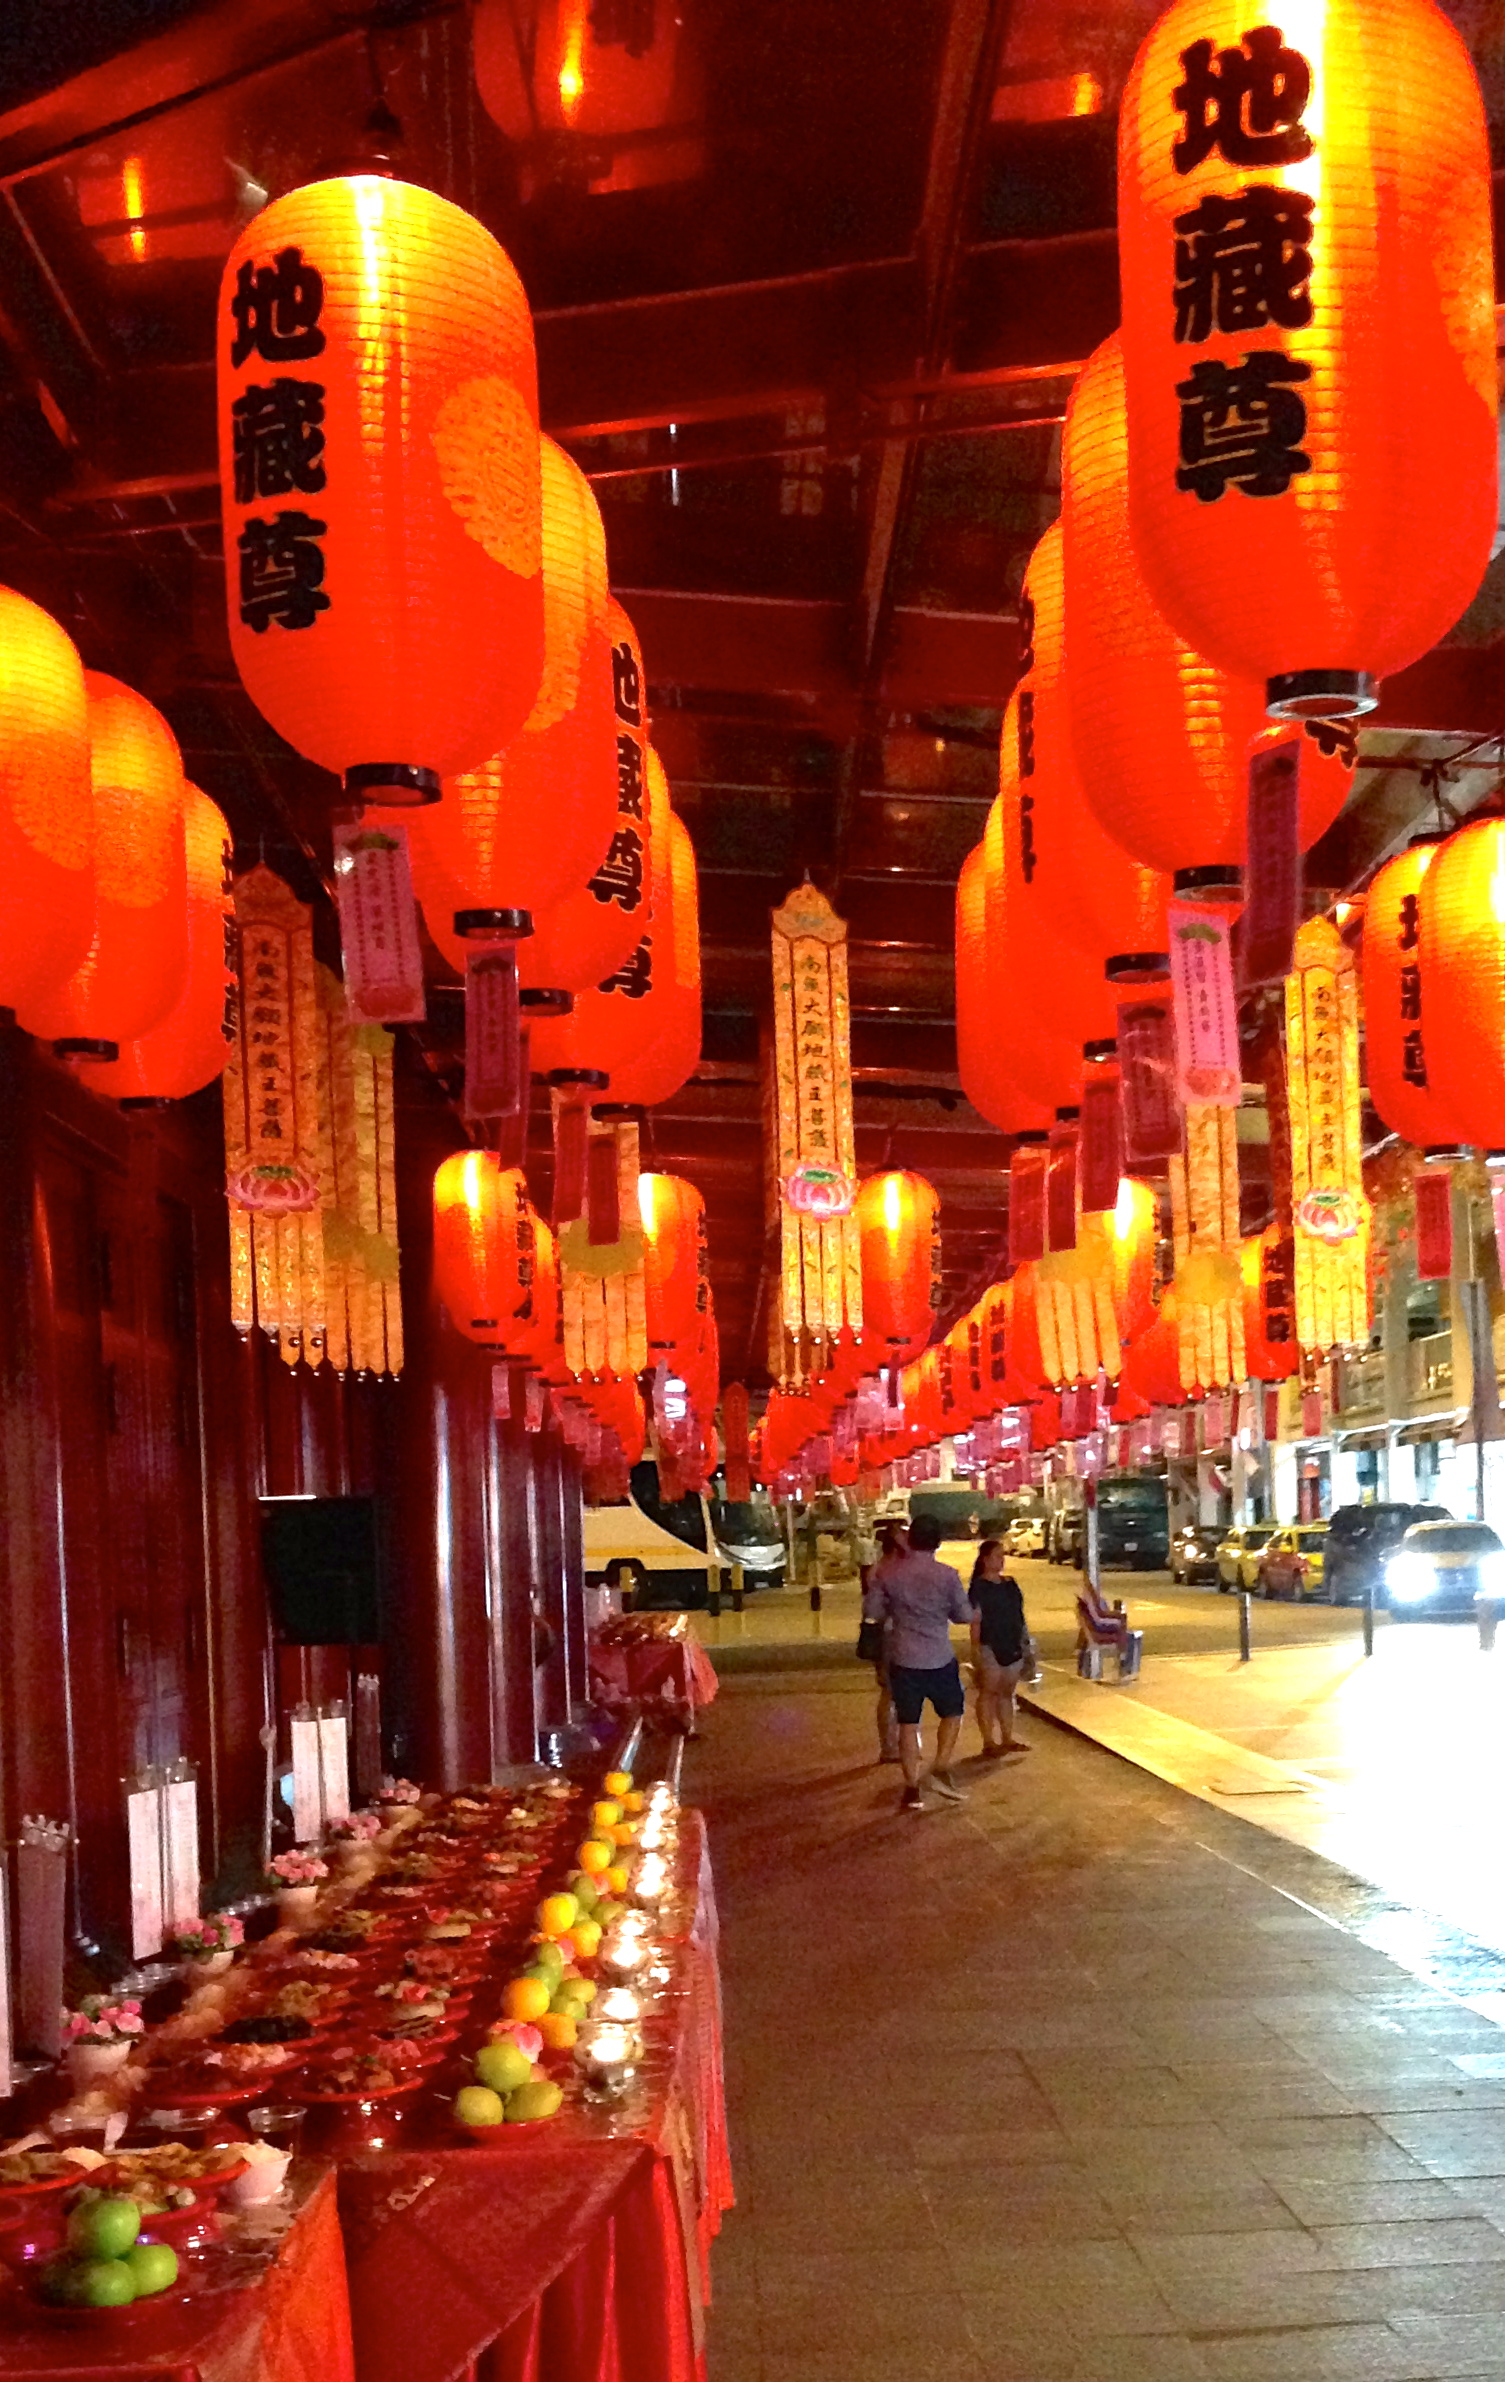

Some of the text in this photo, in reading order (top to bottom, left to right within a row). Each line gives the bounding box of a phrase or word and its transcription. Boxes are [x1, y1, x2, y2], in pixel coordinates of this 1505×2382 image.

[230, 247, 330, 632] 地藏尊
[1172, 26, 1316, 503] 地藏尊
